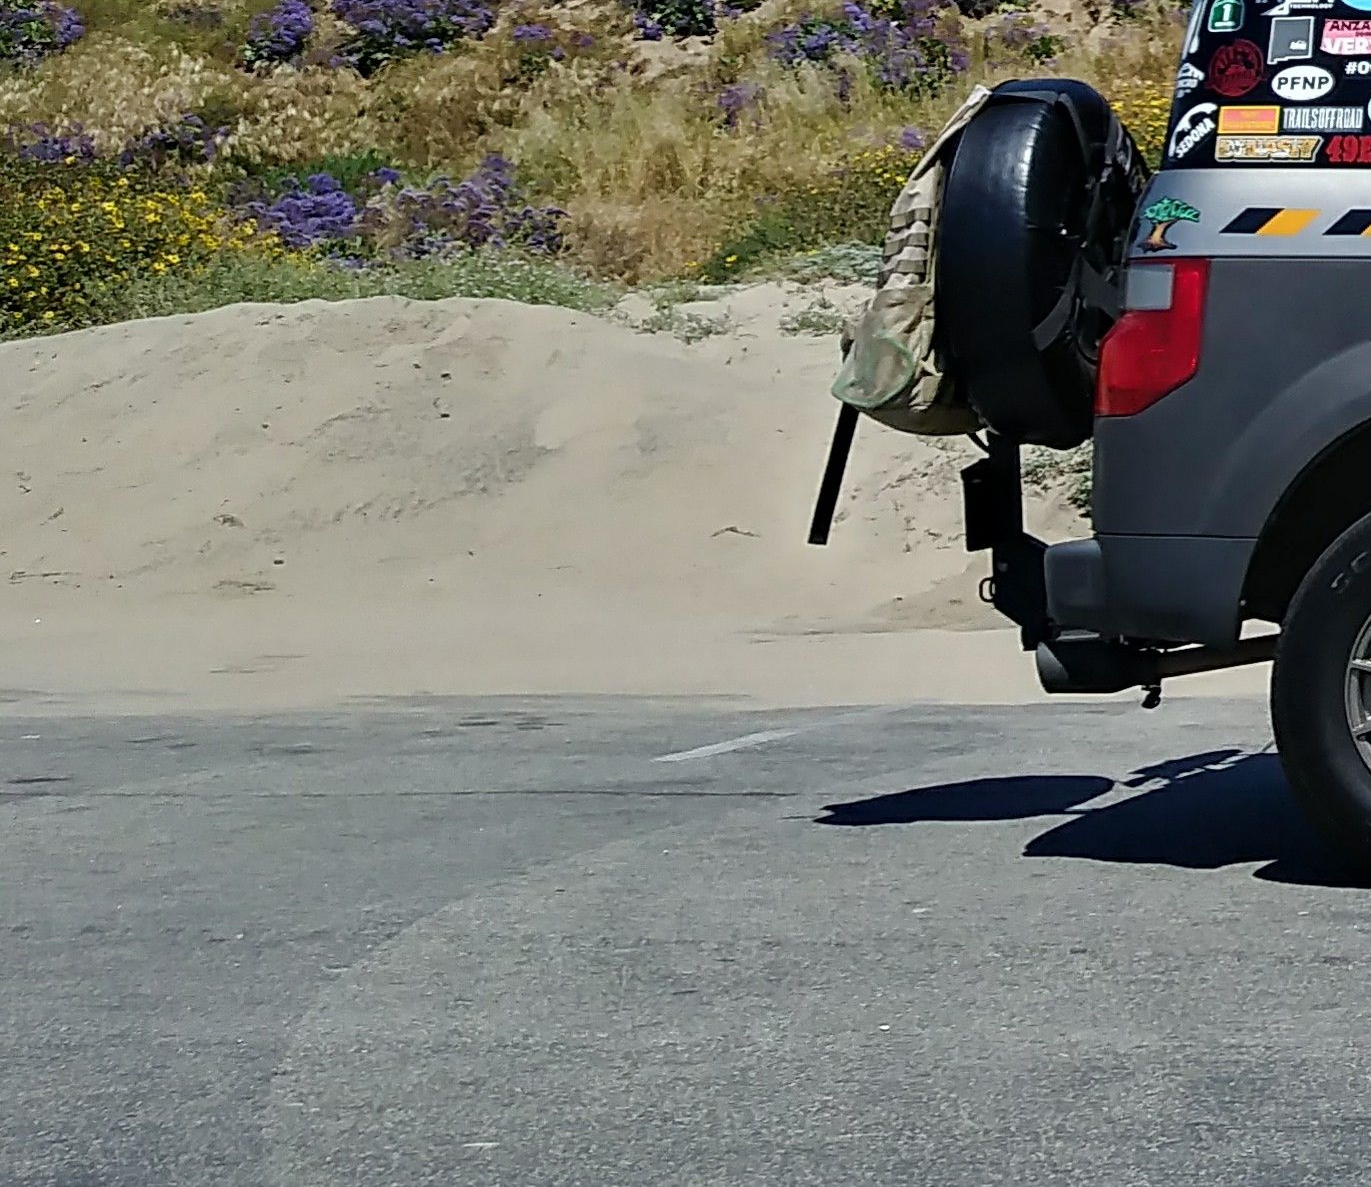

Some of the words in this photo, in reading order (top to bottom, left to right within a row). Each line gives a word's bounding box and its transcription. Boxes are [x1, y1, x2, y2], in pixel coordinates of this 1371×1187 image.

[1214, 3, 1235, 27] 1
[1277, 76, 1330, 90] PFNP
[1175, 117, 1217, 159] SEDONA
